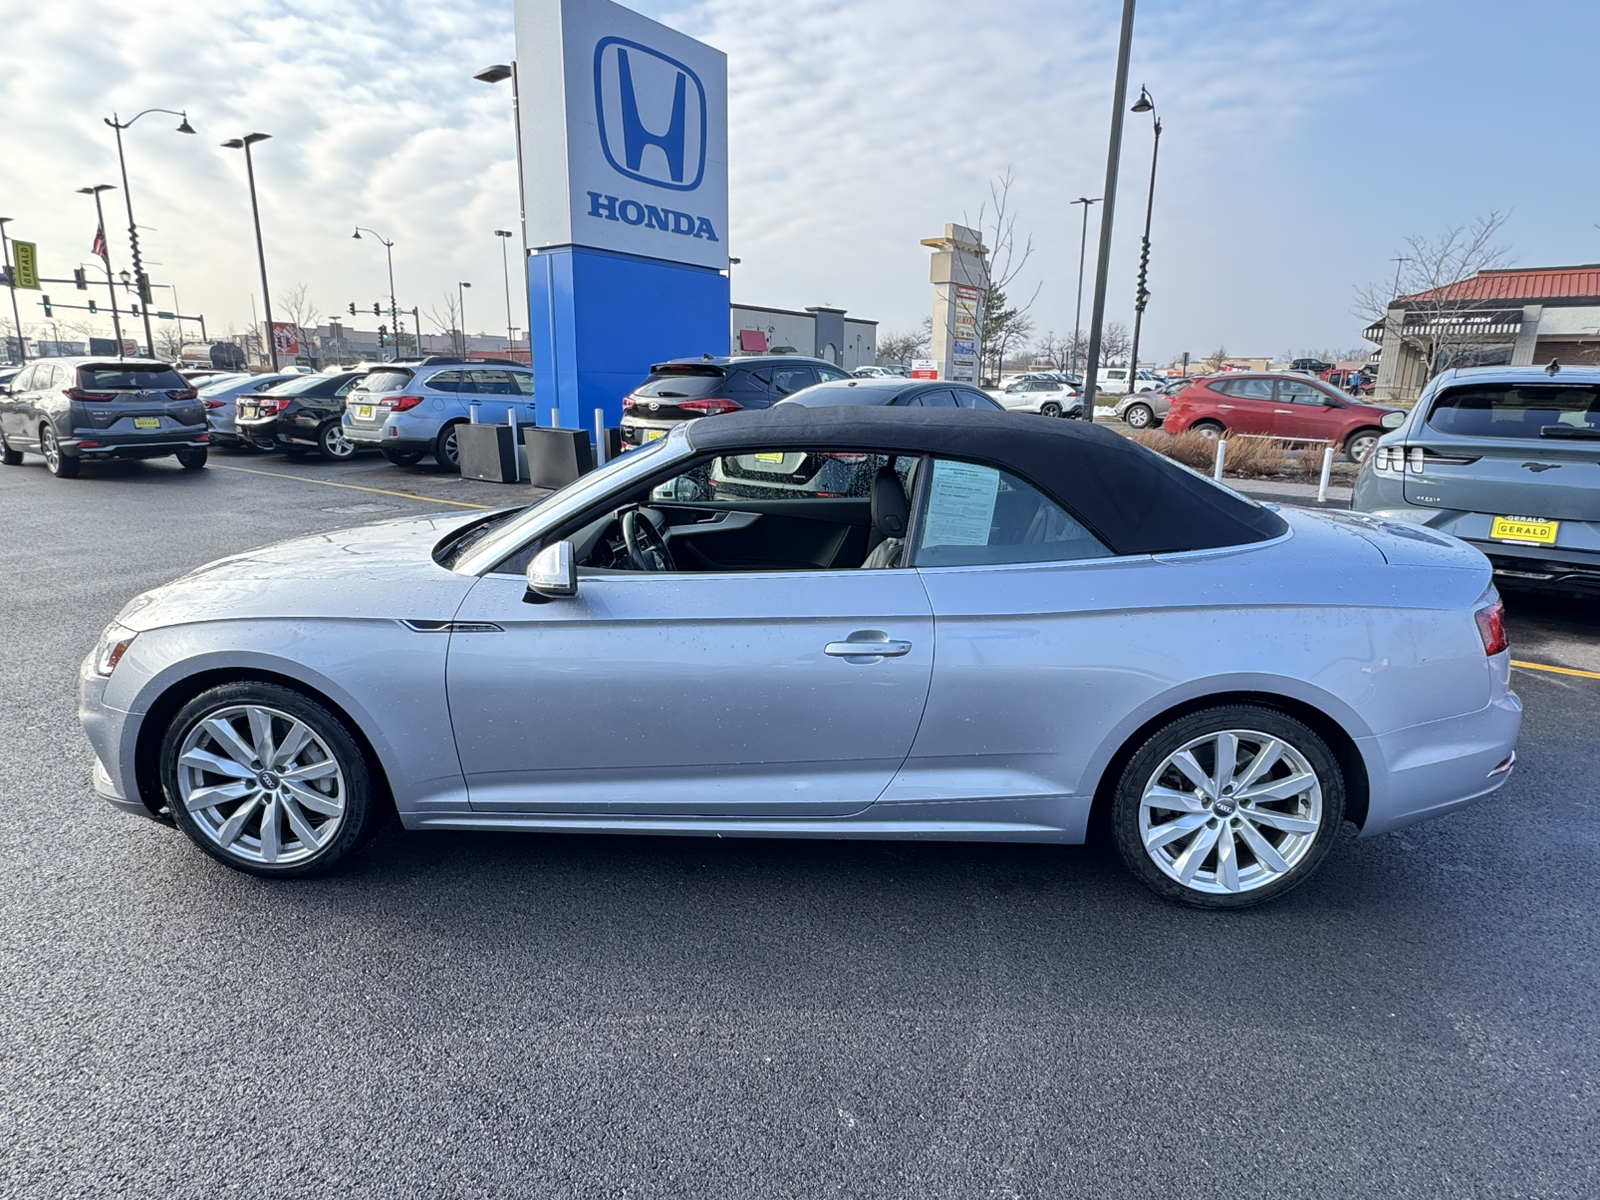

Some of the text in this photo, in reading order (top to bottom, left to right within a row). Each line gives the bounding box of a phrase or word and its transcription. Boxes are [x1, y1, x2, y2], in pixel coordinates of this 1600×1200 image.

[587, 190, 719, 242] HONDA
[20, 247, 32, 284] GERALD
[1500, 525, 1548, 537] GERALD
